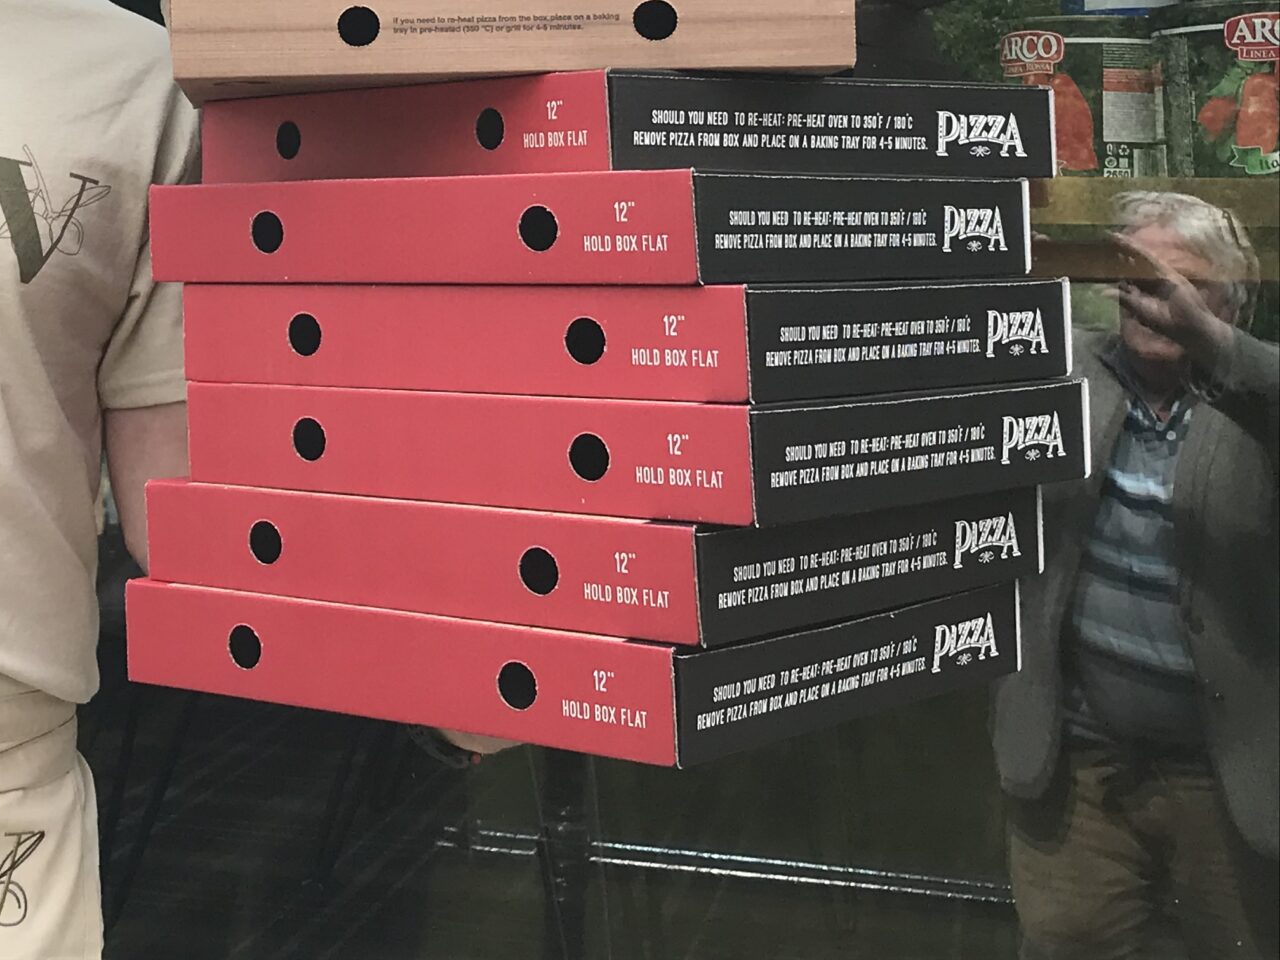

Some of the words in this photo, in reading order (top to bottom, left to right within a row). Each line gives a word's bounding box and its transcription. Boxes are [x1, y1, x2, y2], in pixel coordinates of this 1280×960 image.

[1001, 35, 1058, 62] ARCO
[1242, 48, 1277, 58] LINEA
[650, 110, 684, 124] SHOULD
[688, 111, 704, 124] YOU
[707, 111, 728, 125] NEED
[734, 112, 745, 125] TO
[747, 112, 784, 126] RE-HEAT:
[787, 114, 825, 127] PRE-HEAT
[828, 115, 848, 128] OVEN
[851, 115, 861, 128] TO
[523, 132, 544, 149] HOLD
[548, 131, 564, 148] BOX
[567, 130, 588, 146] FLAT
[632, 131, 666, 145] REMOVE
[669, 132, 695, 145] PIZZA
[697, 133, 720, 146] FROM
[722, 133, 739, 146] BOX
[742, 134, 758, 146] AND
[761, 134, 785, 147] PLACE
[788, 135, 799, 147] ON
[802, 135, 807, 147] A
[810, 135, 838, 148] BAKING
[841, 135, 860, 148] TRAY
[862, 136, 876, 148] FOR
[879, 136, 892, 149] 4-5
[894, 136, 930, 149] MINUTES.
[935, 110, 1028, 157] PIZZA
[584, 235, 611, 252] HOLD
[616, 235, 638, 252] BOX
[642, 234, 668, 251] FLAT
[942, 205, 1008, 253] PIZZA
[986, 307, 1050, 358] PIZZA
[631, 348, 661, 366] HOLD
[665, 349, 688, 367] BOX
[691, 350, 719, 368] FLAT
[1001, 410, 1067, 465] PIZZA
[635, 466, 664, 485] HOLD
[669, 468, 692, 487] BOX
[695, 470, 723, 489] FLAT
[953, 511, 1022, 569] PIZZA
[584, 583, 612, 603] HOLD
[616, 586, 639, 605] BOX
[643, 589, 669, 609] FLAT
[931, 611, 999, 674] PIZZA
[711, 681, 740, 702] SHOULD
[743, 678, 756, 695] YOU
[758, 673, 775, 691] NEED
[780, 670, 789, 686] TO
[790, 663, 820, 683] RE-HEAT:
[821, 655, 851, 675] PRE-HEAT
[852, 651, 868, 667] OVEN
[870, 648, 878, 663] TO
[695, 709, 724, 730] REMOVE
[726, 703, 747, 722] PIZZA
[749, 698, 767, 716] FROM
[769, 694, 783, 711] BOX
[784, 690, 797, 707] AND
[798, 685, 819, 703] PLACE
[820, 682, 830, 697] ON
[830, 681, 835, 694] A
[837, 674, 859, 693] BAKING
[861, 670, 875, 686] TRAY
[876, 666, 888, 682] FOR
[889, 663, 900, 678] 4-5
[901, 656, 927, 675] MINUTES.
[562, 699, 591, 720] HOLD
[594, 703, 617, 724] BOX
[620, 708, 647, 729] FLAT
